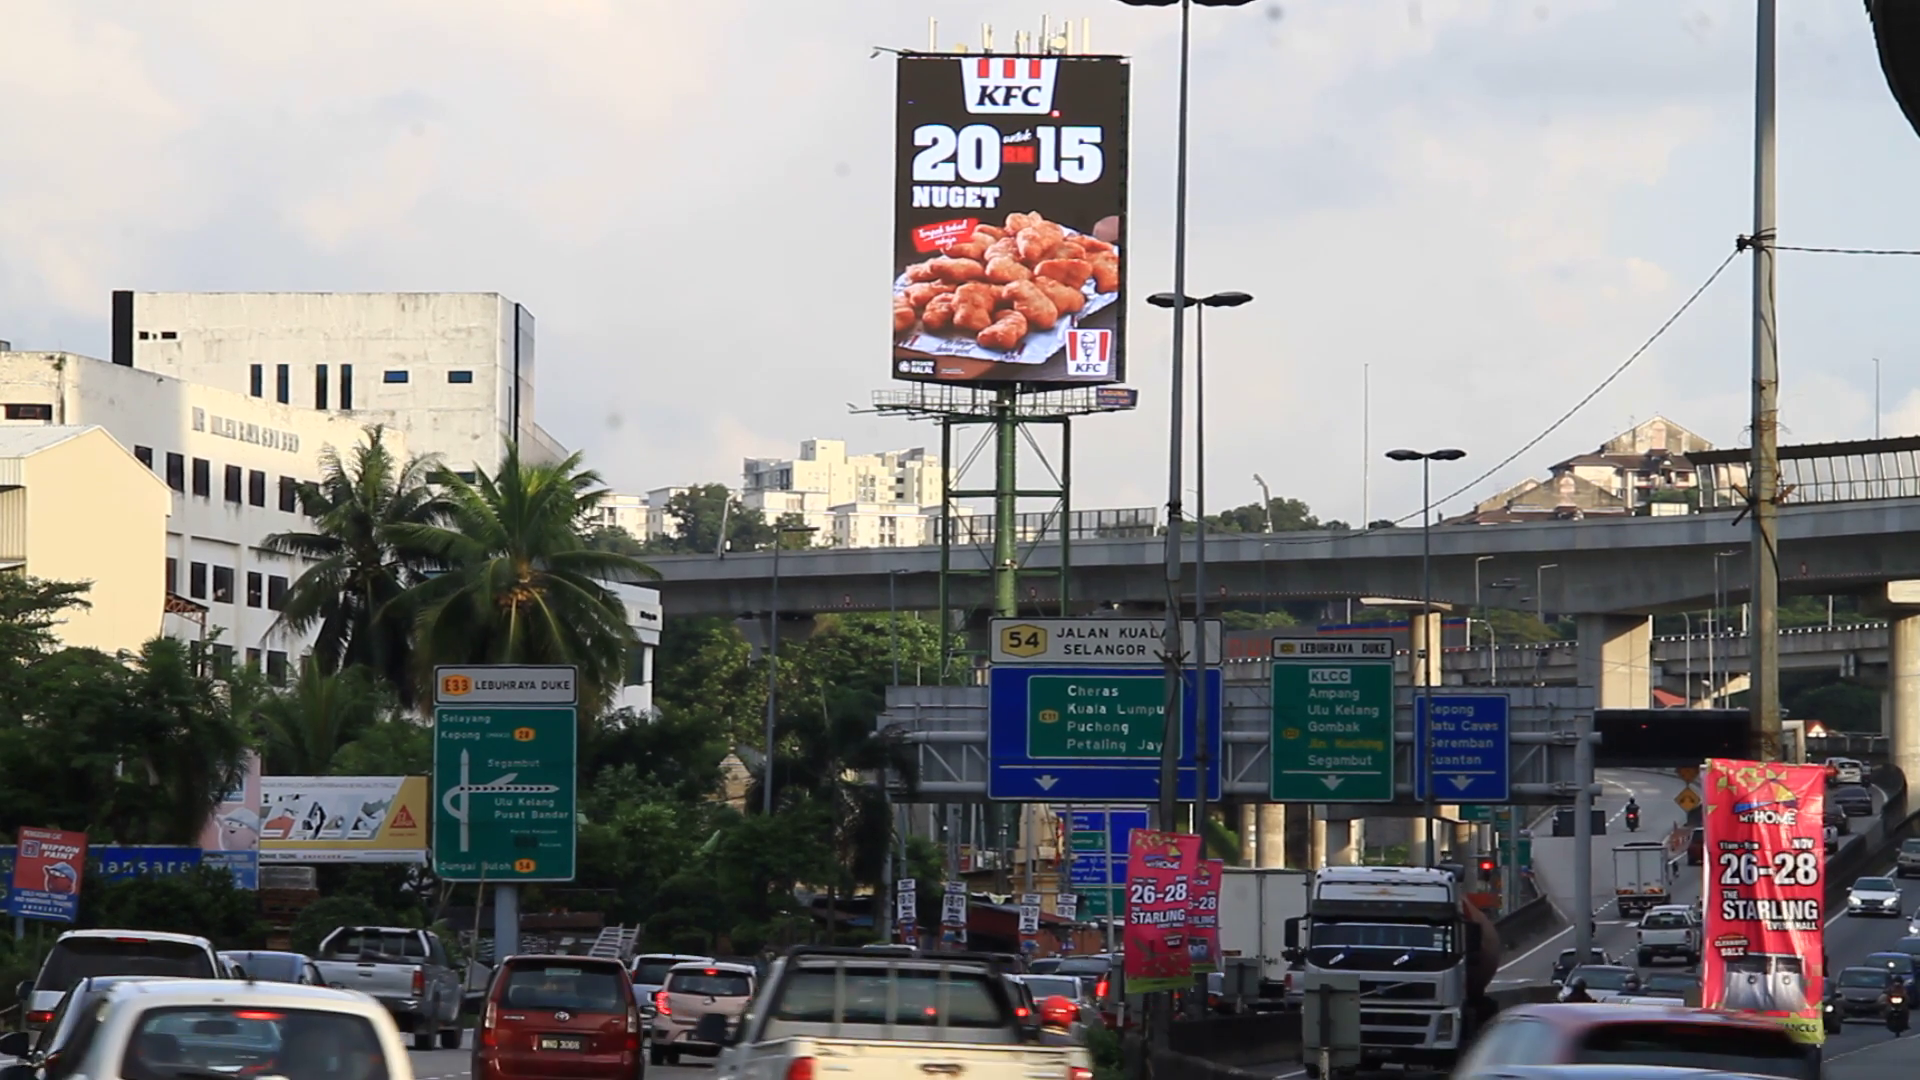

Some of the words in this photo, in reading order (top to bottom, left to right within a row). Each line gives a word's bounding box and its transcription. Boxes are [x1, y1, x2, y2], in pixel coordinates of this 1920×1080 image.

[975, 85, 1042, 106] KFC
[912, 124, 1000, 183] 20
[1036, 125, 1103, 184] 15
[912, 186, 999, 208] NUGET
[1074, 363, 1101, 373] KFC
[1008, 631, 1040, 649] 54
[1056, 627, 1109, 638] JALAN
[1064, 644, 1146, 656] SELANGOR
[1301, 643, 1354, 654] LEBUHRAYA
[1362, 643, 1386, 654] DUKE
[1311, 671, 1349, 682] KLCC
[475, 681, 537, 690] LEBUHRAYA
[541, 681, 571, 690] DUKE
[1067, 685, 1119, 697] Cheras
[1308, 688, 1360, 701] Ampang
[1067, 703, 1107, 715] Kuala
[1117, 703, 1164, 716] Lumpu
[1307, 704, 1329, 715] Ulu
[1335, 704, 1380, 718] Kelang
[441, 714, 491, 724] Selayang
[1067, 720, 1129, 735] Puchong
[1307, 721, 1360, 732] Gombak
[1461, 720, 1499, 731] Caves
[441, 730, 481, 740] Kepong
[1067, 738, 1126, 752] Petaling
[1138, 739, 1163, 752] Jay
[487, 759, 540, 769] Segambut
[1307, 754, 1372, 768] Segambut
[494, 798, 513, 806] Ulu
[518, 798, 555, 808] Kelang
[494, 810, 525, 819] Pusat
[531, 811, 568, 819] Bandar
[40, 843, 80, 854] NIPPON
[1792, 838, 1814, 849] NOV
[43, 851, 75, 861] PAINT
[1720, 853, 1818, 885] 26-28
[1130, 883, 1187, 905] 26-28
[1722, 891, 1738, 900] THE
[1722, 899, 1818, 920] STARLING
[1131, 909, 1186, 924] STARLING
